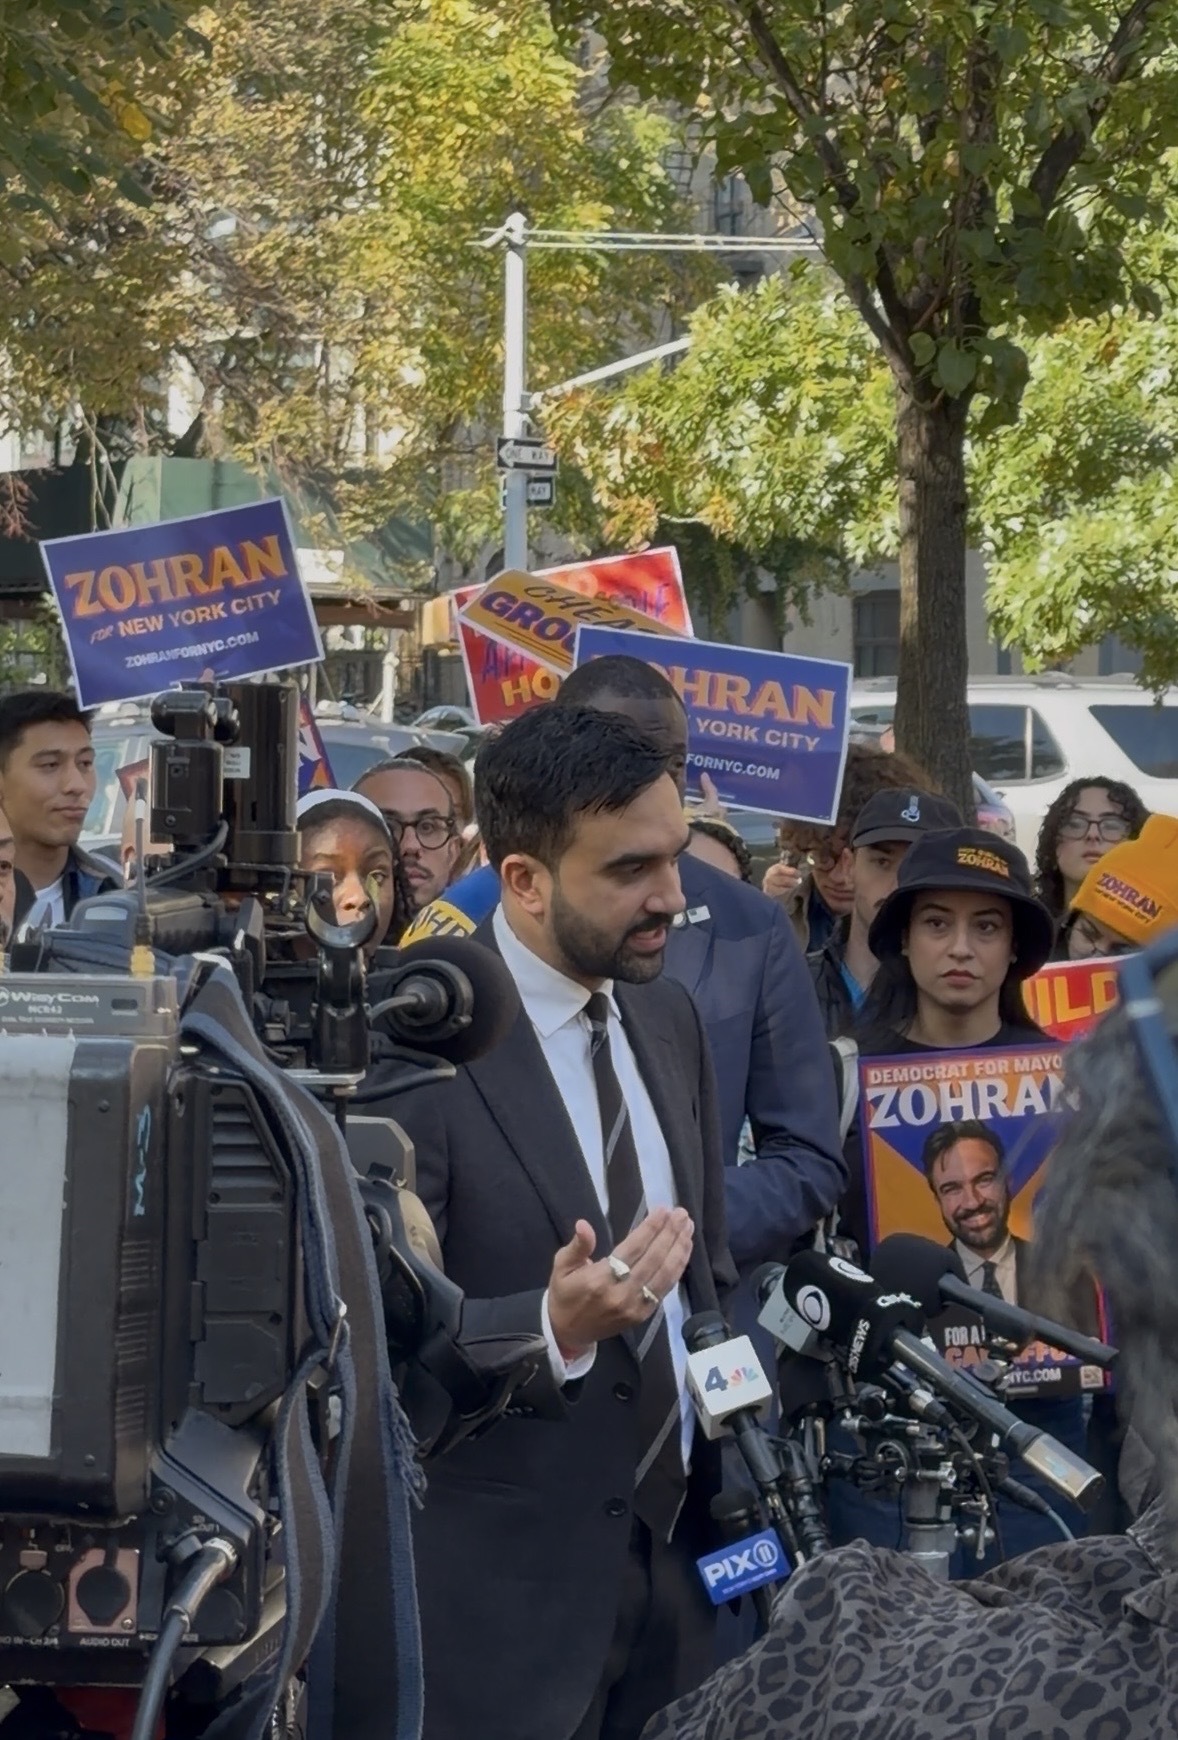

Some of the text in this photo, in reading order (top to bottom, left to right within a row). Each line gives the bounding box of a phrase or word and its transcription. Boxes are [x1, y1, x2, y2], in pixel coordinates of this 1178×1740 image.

[64, 534, 288, 619] ZOHRAN
[119, 614, 164, 637] NEW
[169, 602, 227, 628] YORK
[231, 589, 281, 616] CITY
[524, 586, 637, 629] CHEA
[125, 631, 260, 669] ZOHRANFORNYC.COM
[501, 666, 560, 707] HO
[648, 661, 836, 729] HRAN
[696, 717, 820, 751] YORK CITY
[686, 753, 780, 780] FORNYC.COM
[1097, 873, 1162, 919] ZOHRAN
[1022, 971, 1119, 1028] ILD
[869, 1055, 1063, 1085] DEMOCRAT FOR MAYO
[944, 1327, 968, 1346] FOR
[705, 1366, 728, 1393] 4
[1009, 1367, 1062, 1384] NYC.COM
[80, 1637, 110, 1647] AUDIO
[111, 1637, 130, 1647] OUT
